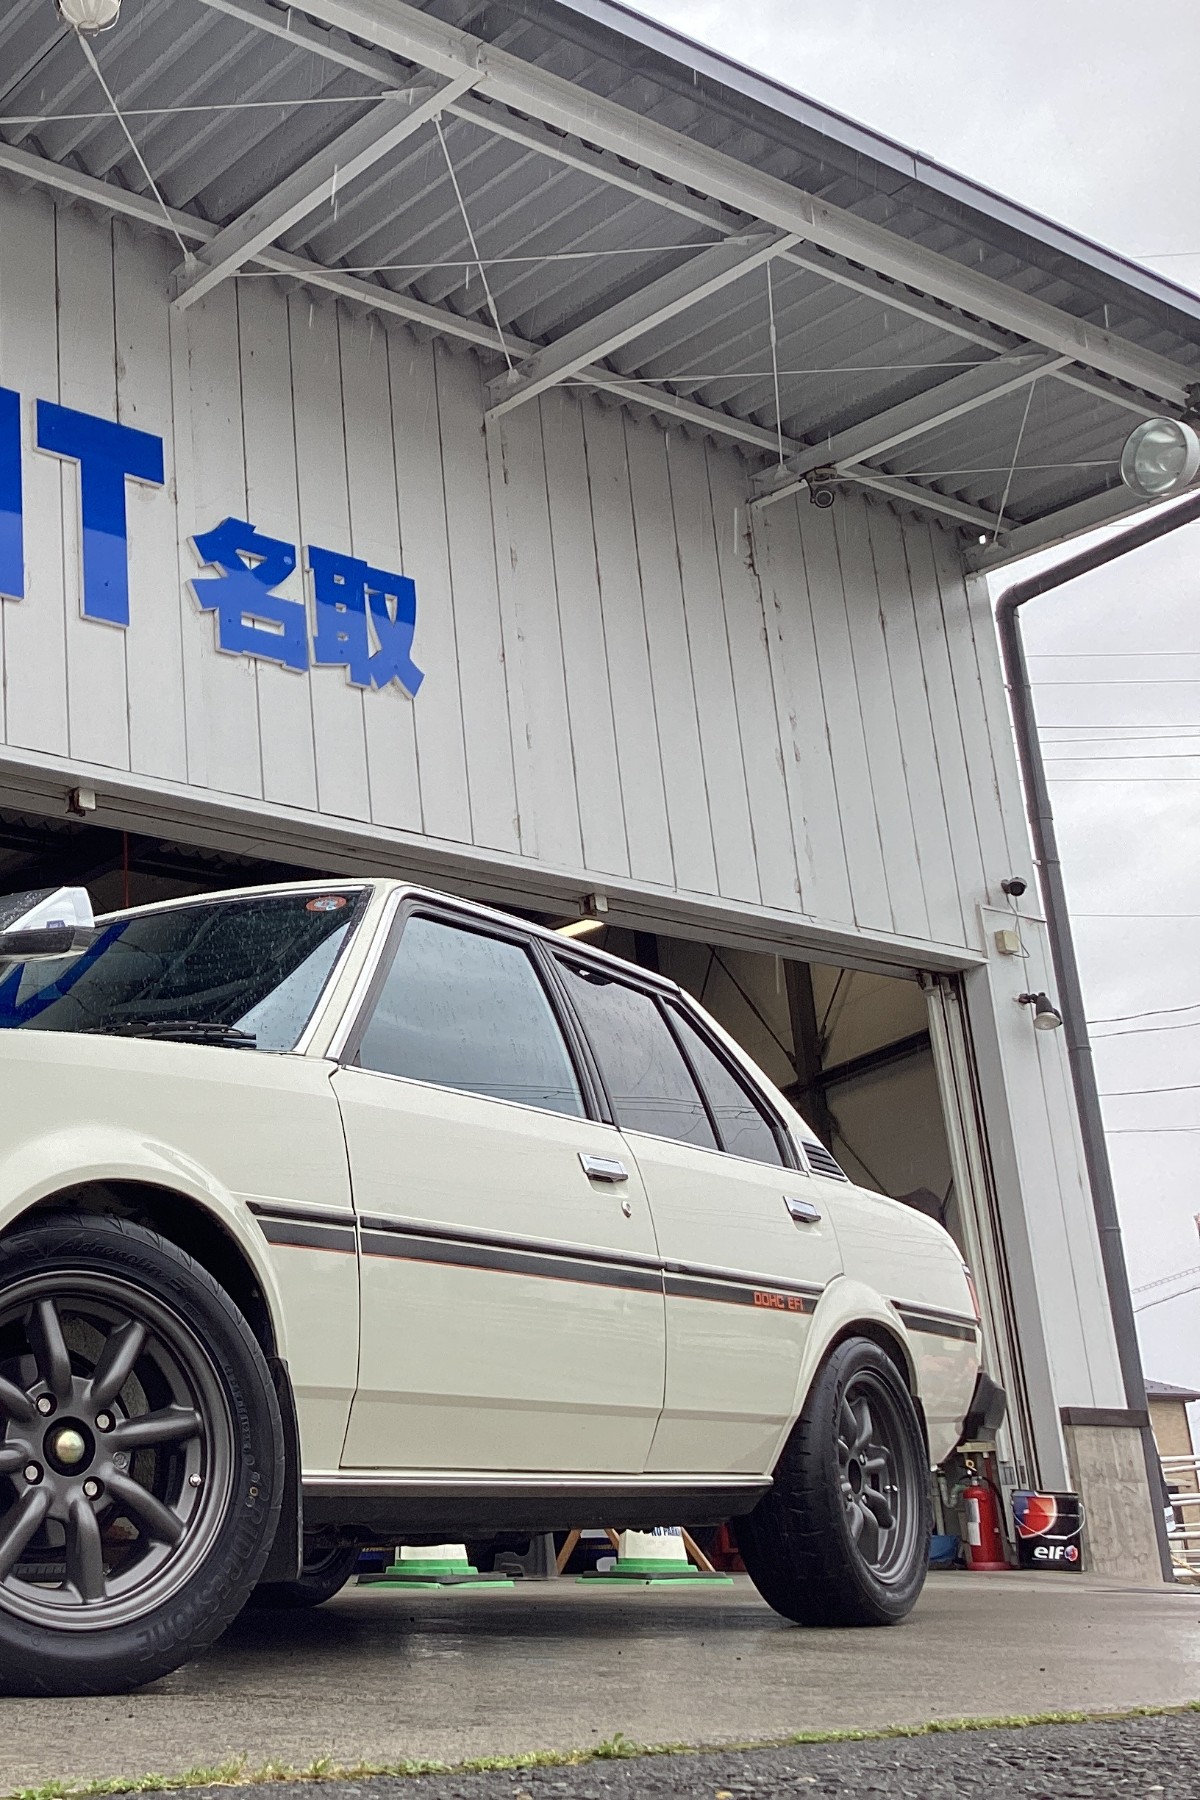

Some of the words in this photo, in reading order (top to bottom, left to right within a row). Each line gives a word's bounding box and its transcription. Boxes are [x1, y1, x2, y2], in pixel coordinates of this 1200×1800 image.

[186, 516, 425, 700] 名取
[754, 1291, 785, 1309] DOHC
[787, 1296, 804, 1311] EFI
[1034, 1545, 1064, 1560] elf
